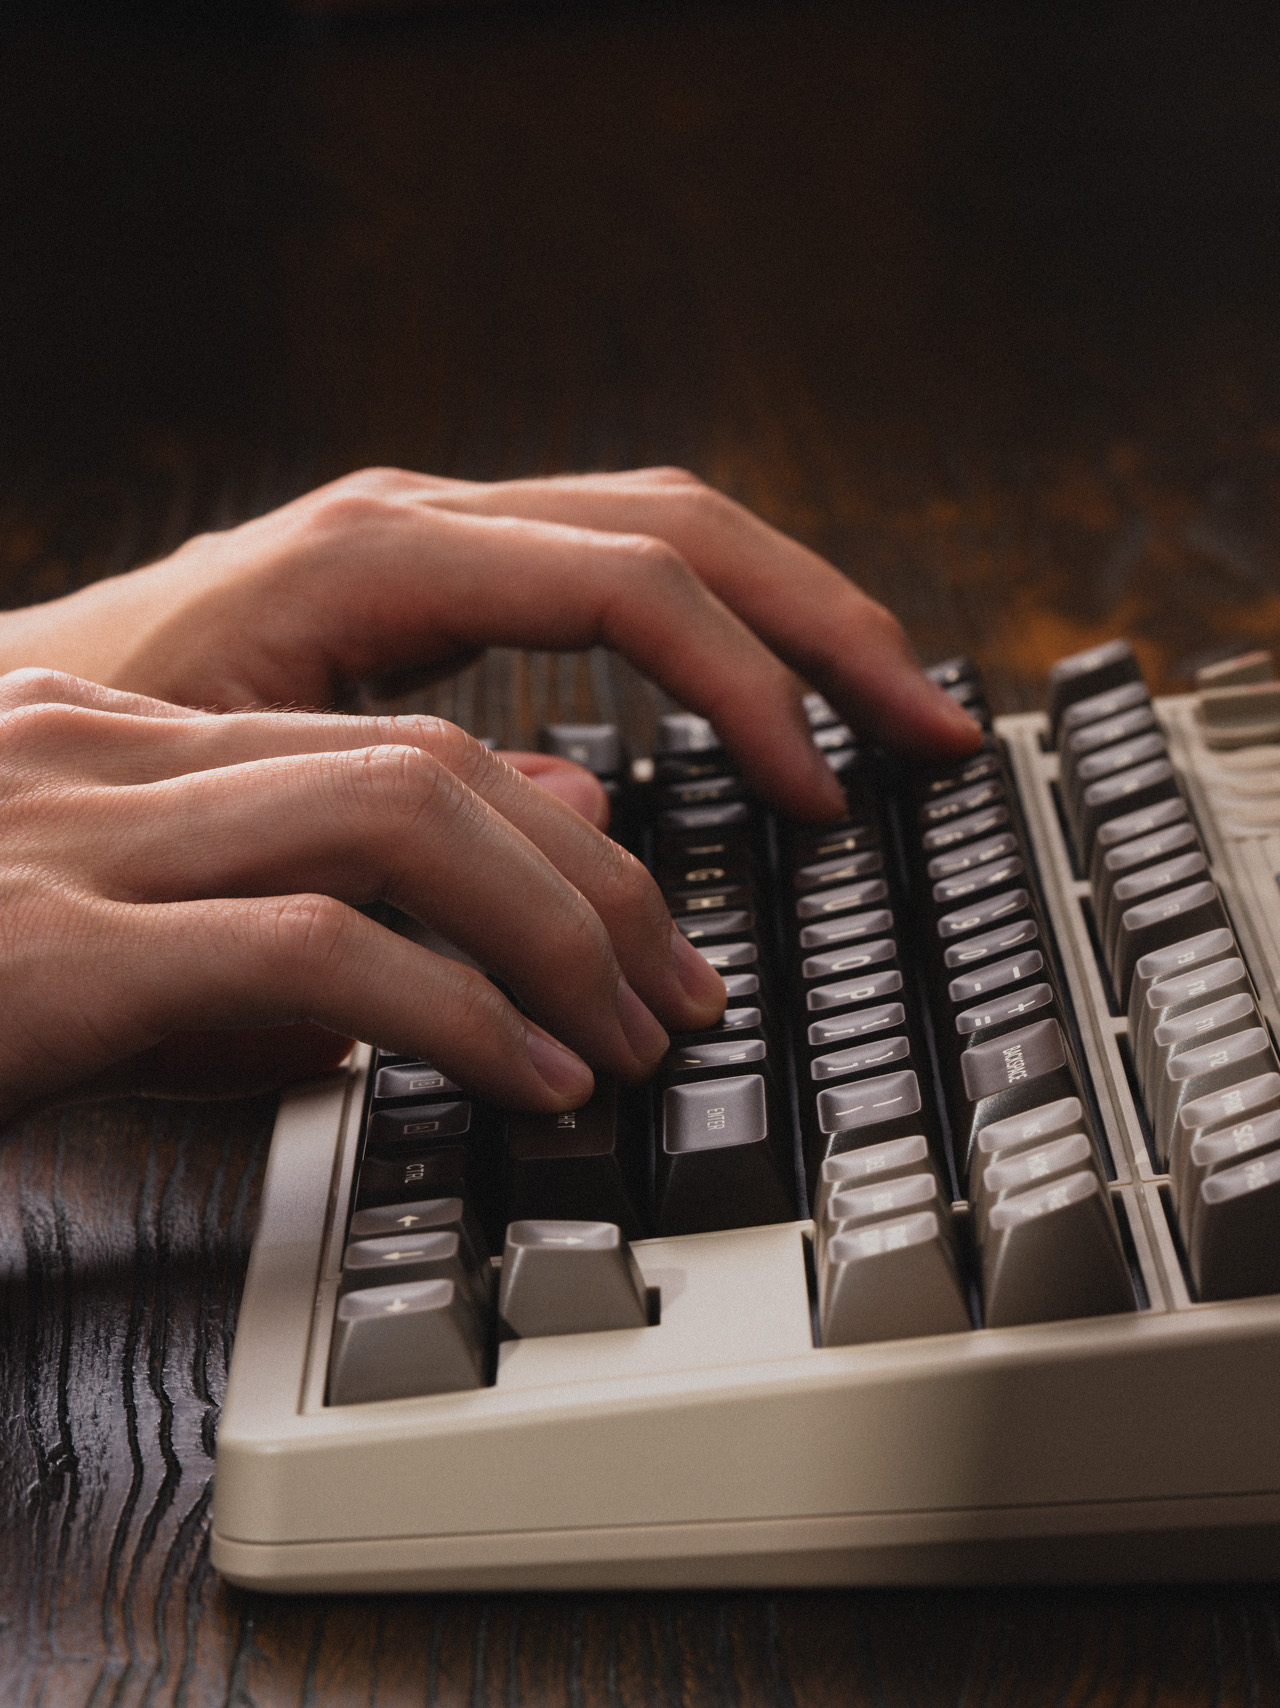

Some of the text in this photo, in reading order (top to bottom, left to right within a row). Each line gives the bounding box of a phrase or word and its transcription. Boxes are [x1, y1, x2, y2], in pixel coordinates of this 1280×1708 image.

[1003, 1044, 1027, 1084] BACKSPACE
[1208, 1050, 1229, 1068] F12
[557, 1111, 576, 1129] HIFT
[706, 1107, 725, 1131] ENTER
[404, 1163, 425, 1184] CTRL
